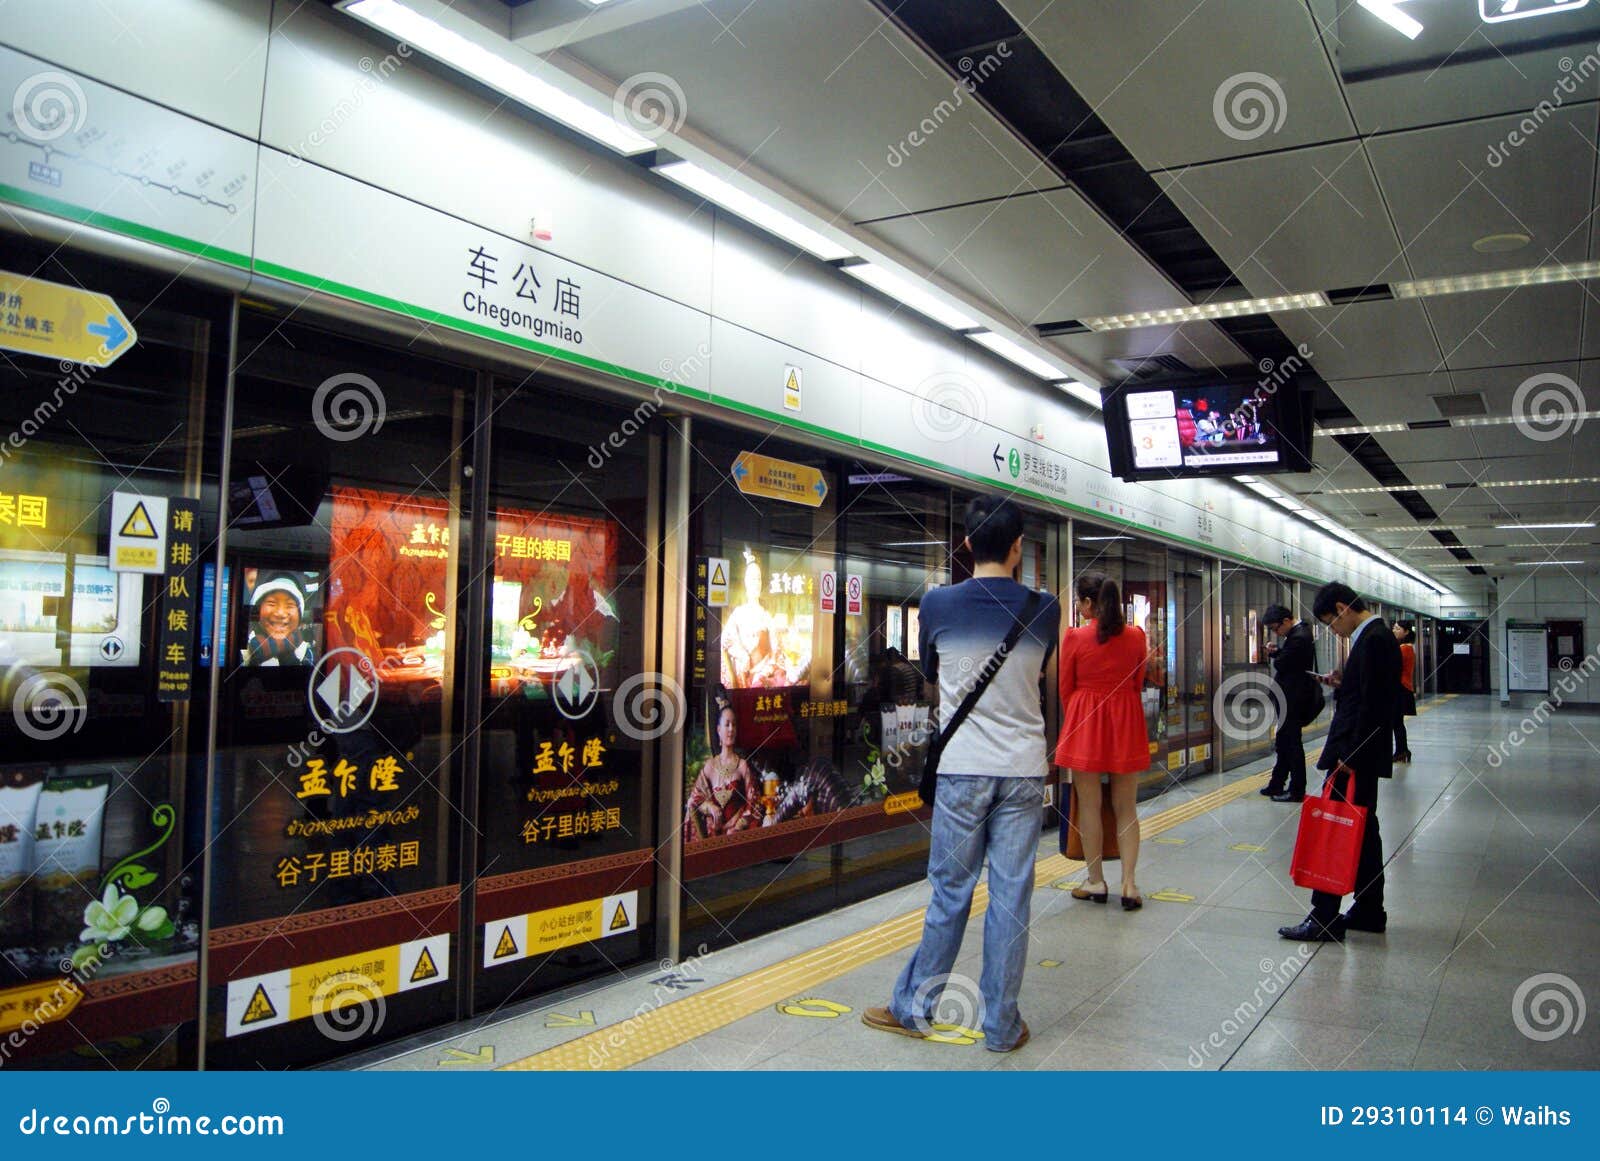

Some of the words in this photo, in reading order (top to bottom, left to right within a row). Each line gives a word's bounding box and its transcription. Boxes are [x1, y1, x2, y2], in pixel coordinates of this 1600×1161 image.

[467, 246, 581, 320] 车公庙
[463, 291, 583, 344] Chegongmiao
[496, 534, 571, 562] 子里的泰国
[165, 510, 193, 665] 请排队候车
[160, 671, 190, 681] Please
[177, 682, 189, 693] up
[522, 807, 621, 843] 谷子里的泰国
[276, 840, 420, 887] 谷子里的泰国
